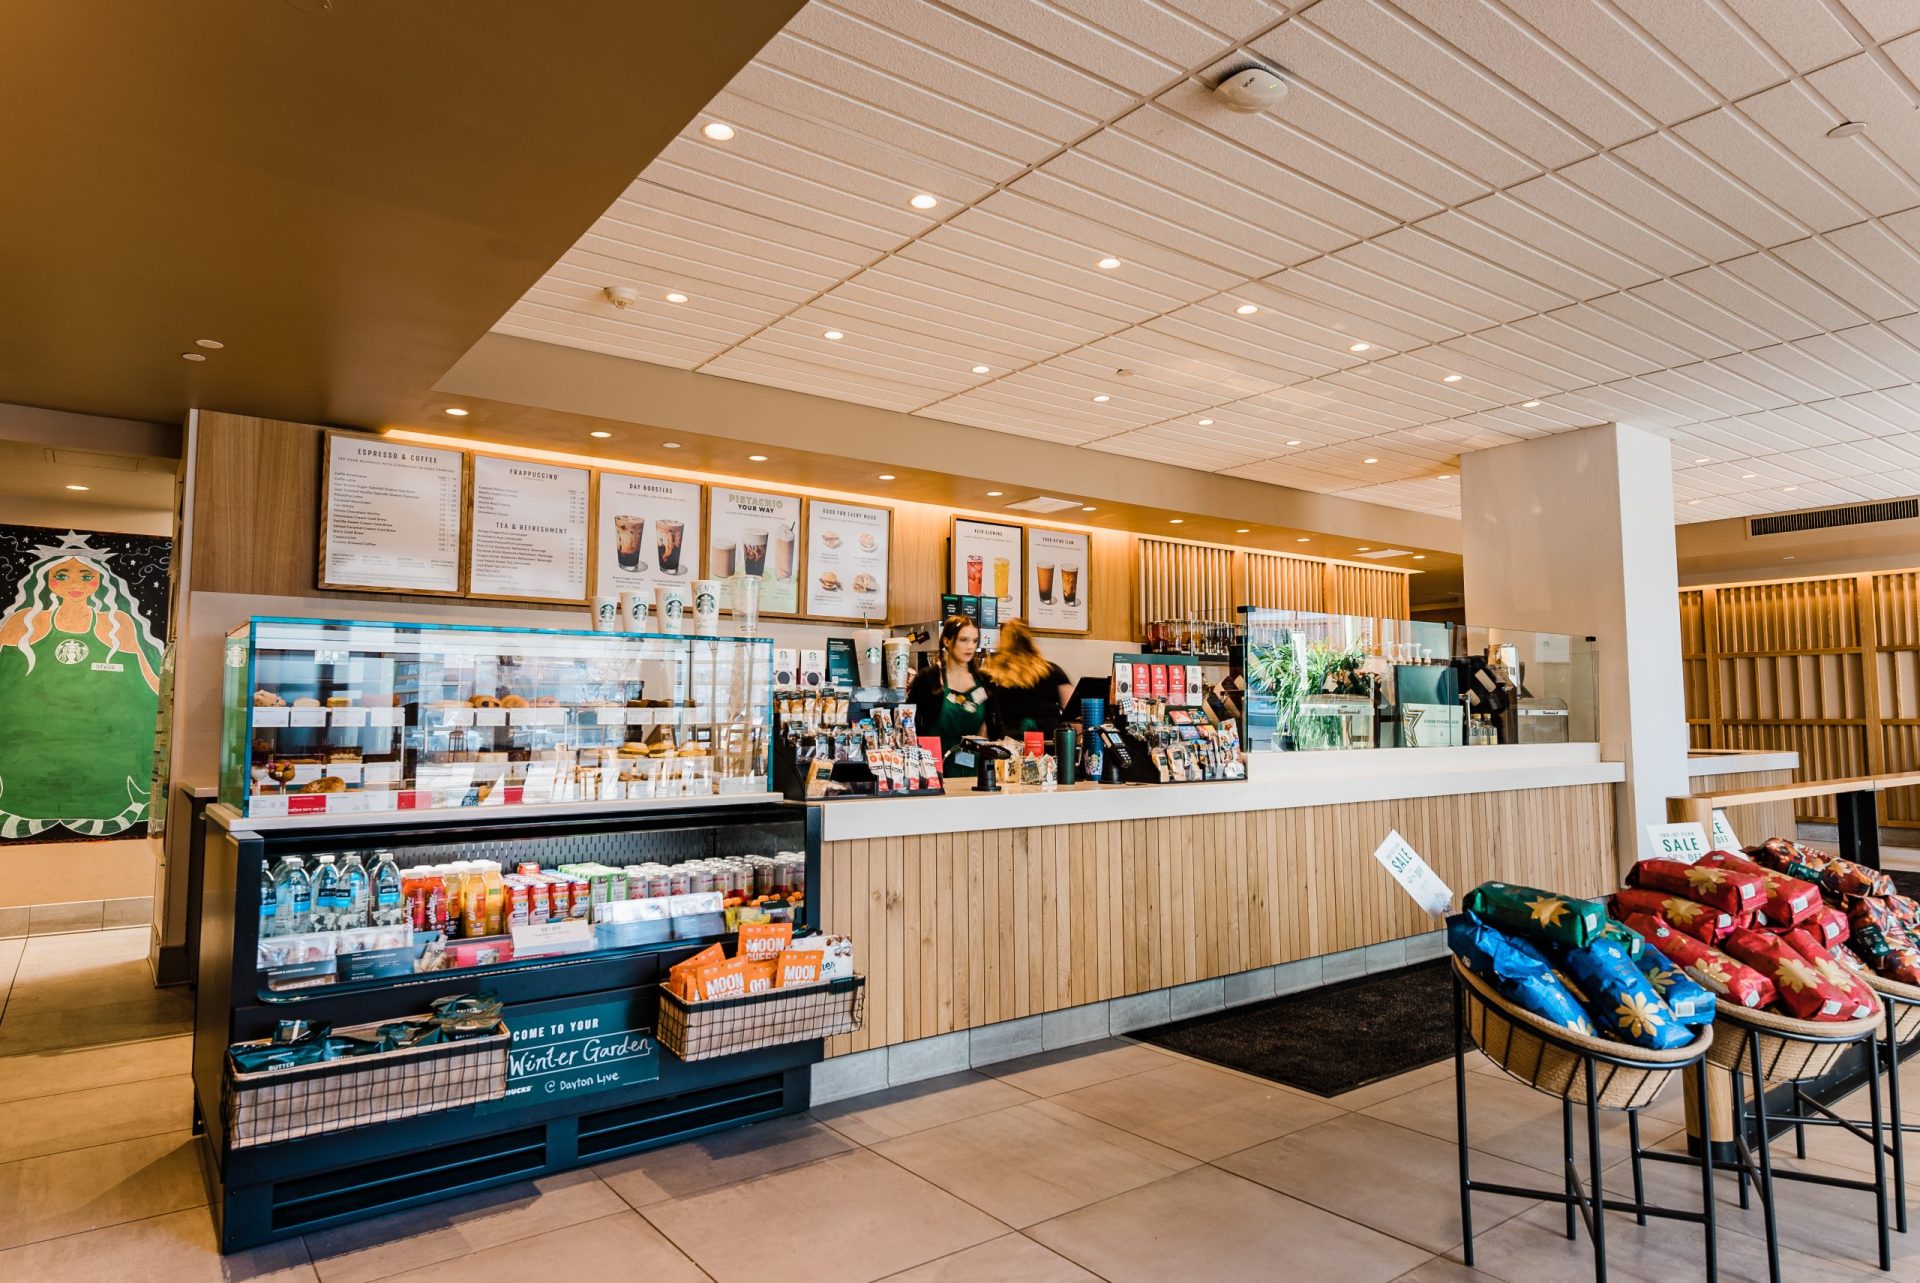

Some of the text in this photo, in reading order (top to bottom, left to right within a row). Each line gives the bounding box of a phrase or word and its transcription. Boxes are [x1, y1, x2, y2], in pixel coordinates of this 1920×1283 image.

[358, 448, 398, 460] ESPRESSO
[411, 454, 438, 464] COFFEE
[510, 468, 559, 481] FRAPPUCCINO
[643, 485, 672, 494] BOOSTERS
[728, 493, 784, 509] PISTACHIO
[738, 503, 774, 514] YOUR WAY
[496, 522, 508, 530] TEA
[520, 524, 567, 534] REFRESHMENT
[1662, 837, 1700, 852] SALE
[1391, 847, 1413, 874] SALE
[746, 937, 785, 953] MOON
[784, 965, 816, 980] MOON
[706, 972, 745, 996] MOON
[513, 1018, 600, 1042] COME TO YOUR
[509, 1035, 653, 1077] Winter Garden
[268, 1061, 295, 1071] BUTTER
[544, 1071, 621, 1094] @ Dayton Live
